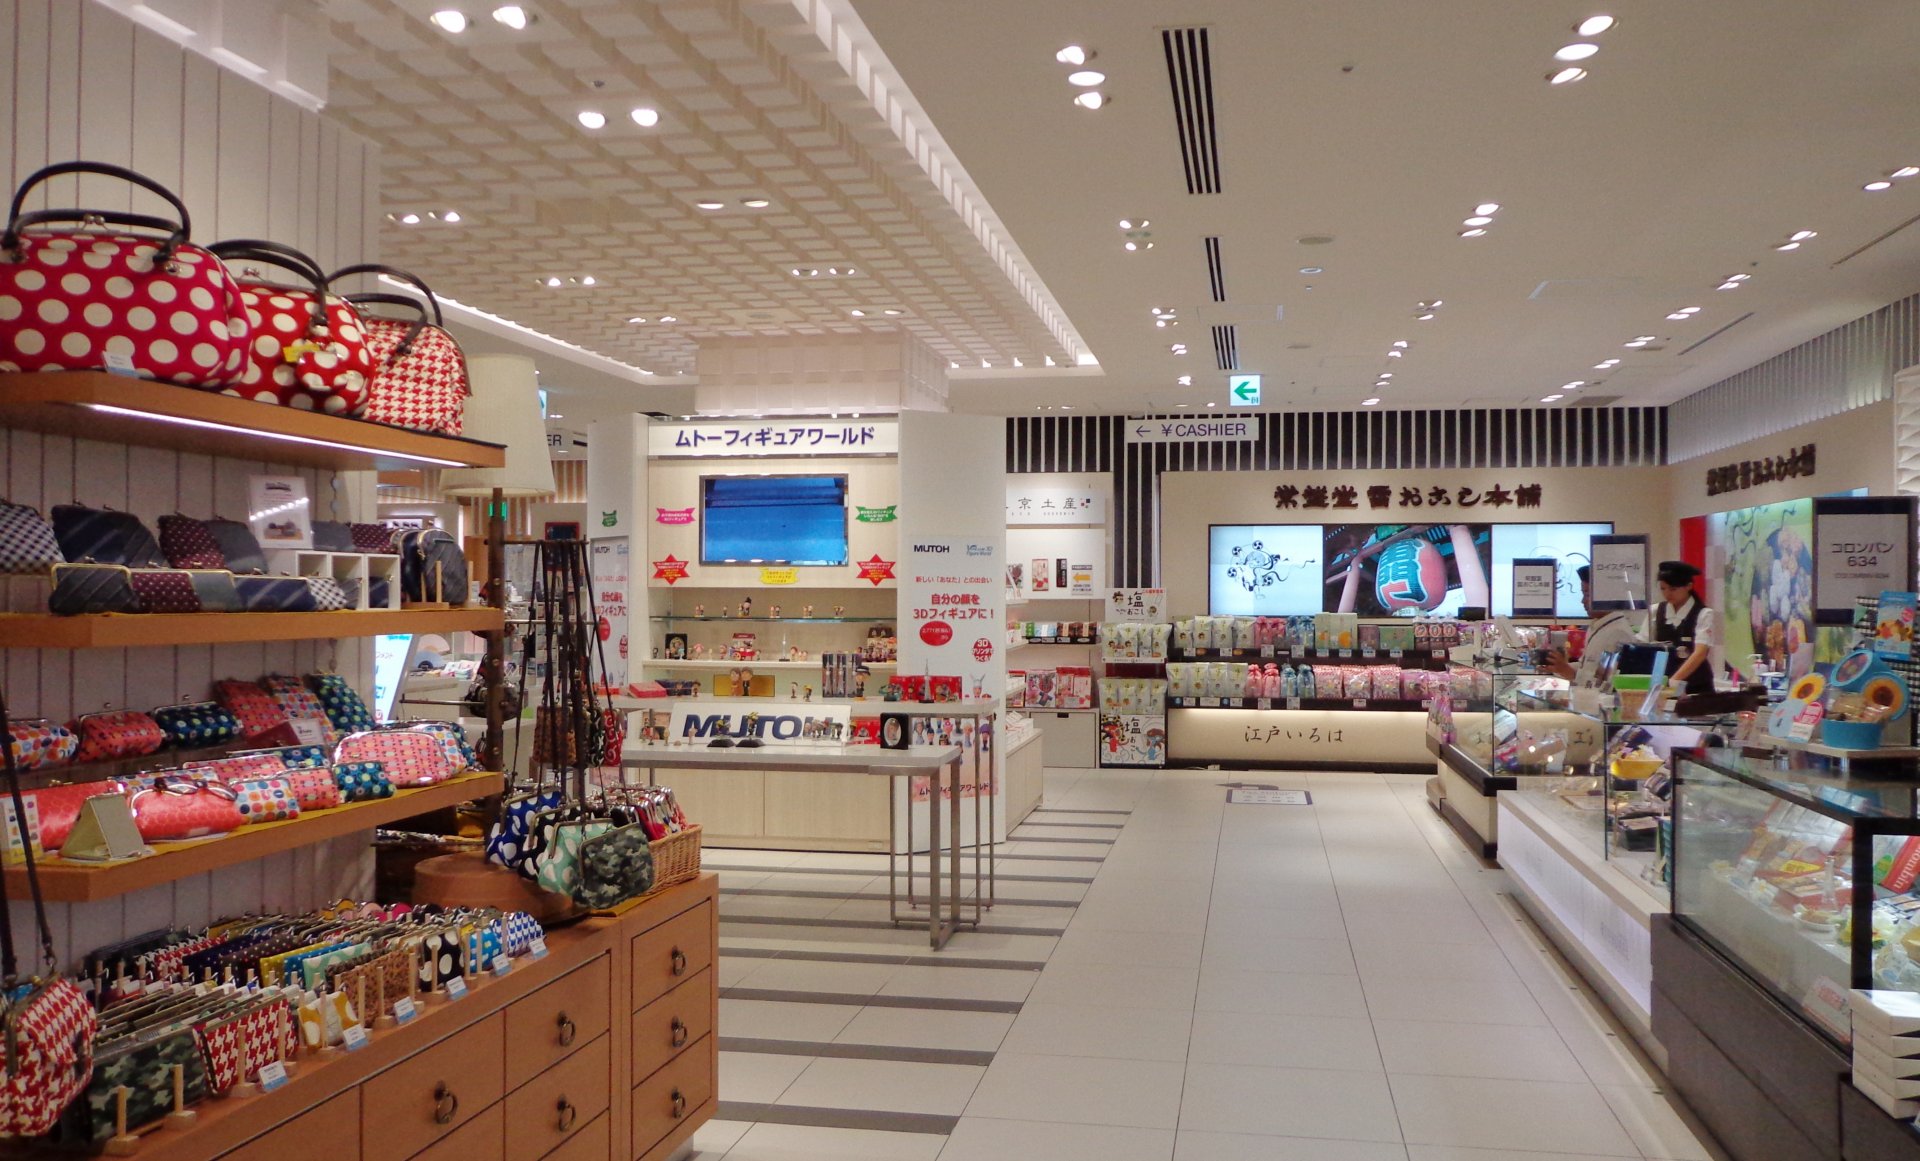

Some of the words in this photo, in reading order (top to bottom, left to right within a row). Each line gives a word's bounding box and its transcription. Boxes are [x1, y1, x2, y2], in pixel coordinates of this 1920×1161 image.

[675, 426, 875, 447] ムトーフィギュアワールド
[1175, 423, 1246, 437] CASHIER
[1006, 496, 1078, 510] 京土産
[913, 544, 950, 553] MUTOH
[1847, 556, 1878, 567] 634
[931, 593, 981, 605] 自分の顔を
[1125, 717, 1141, 734] 塩
[1244, 725, 1344, 744] 江戸いろは
